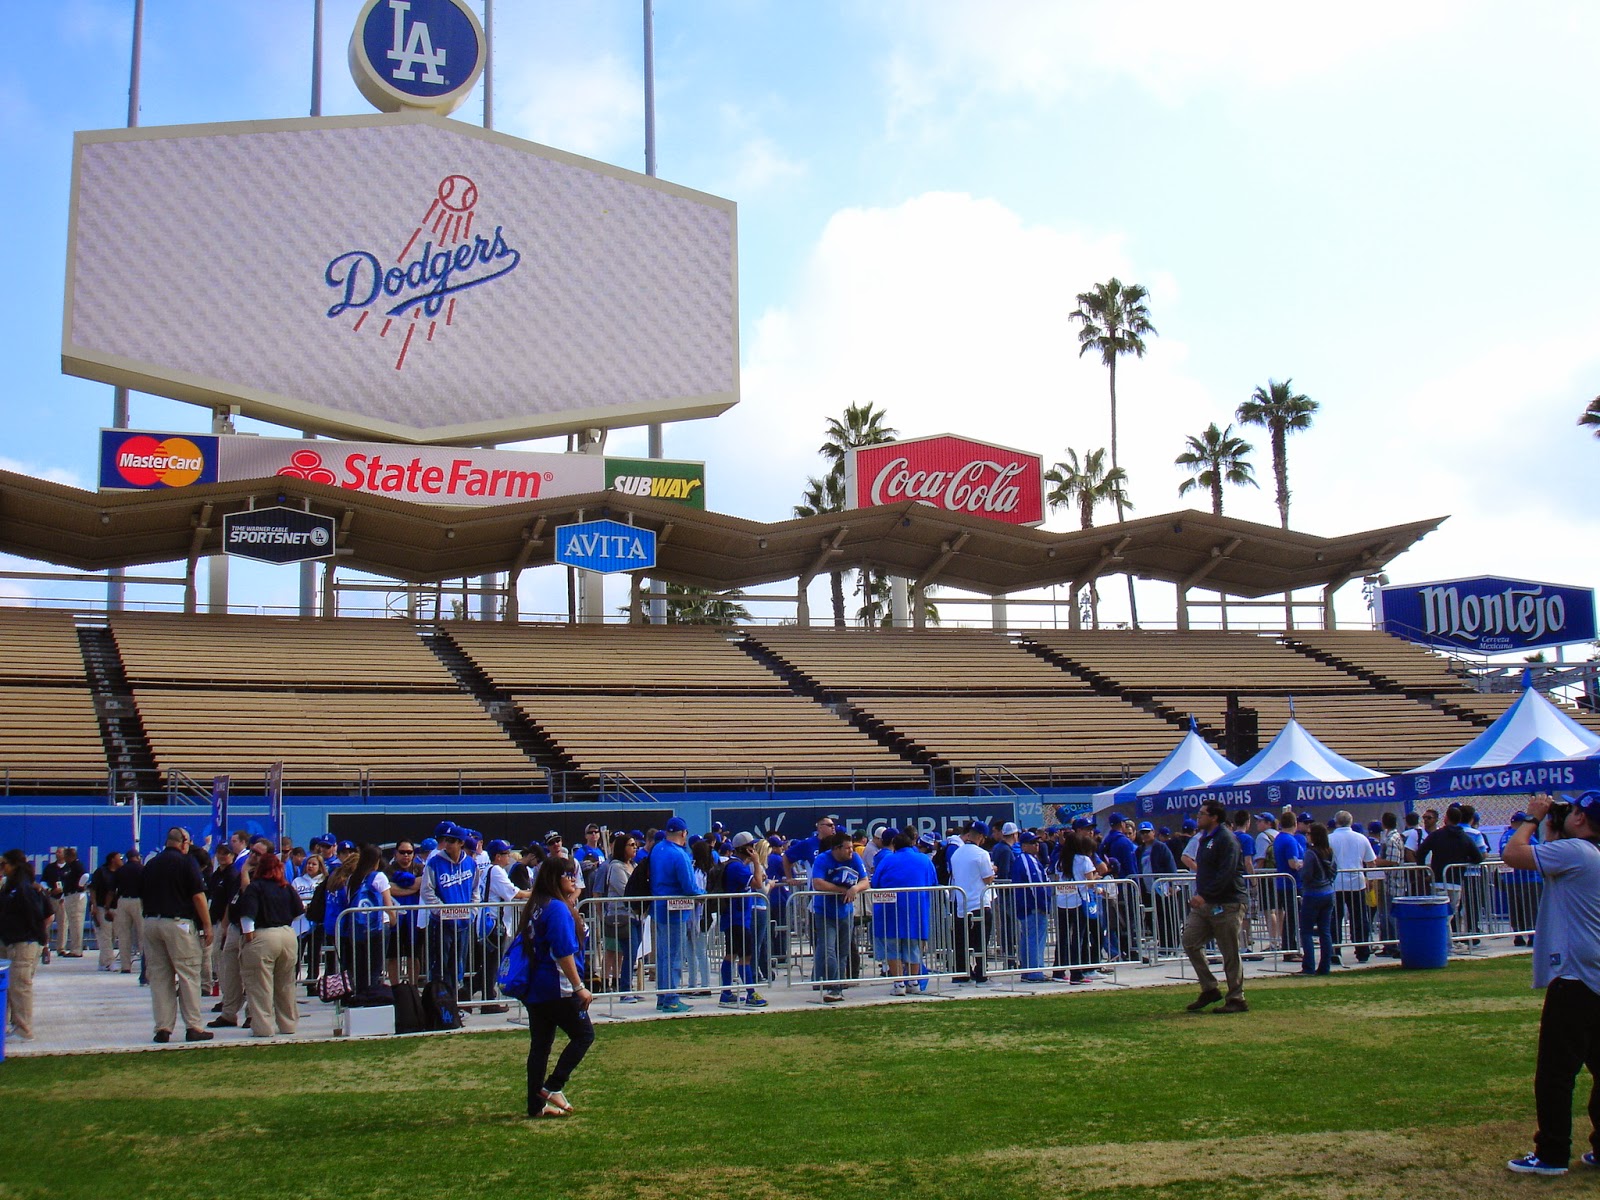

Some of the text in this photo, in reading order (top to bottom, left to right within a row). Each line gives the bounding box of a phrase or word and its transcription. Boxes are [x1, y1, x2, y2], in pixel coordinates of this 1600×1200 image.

[387, 1, 446, 85] LA
[325, 226, 520, 318] Dodgers
[119, 452, 202, 471] MasterCard
[609, 475, 701, 499] SUBWAY
[871, 457, 1028, 513] Coca-Cola
[229, 531, 310, 545] SPORTSNET
[564, 532, 648, 560] AVITA
[1419, 586, 1565, 641] Montejo
[1479, 642, 1514, 650] Mexicana
[1481, 635, 1510, 643] Cerveza
[1296, 780, 1396, 801] AUTOGRAPHS
[1449, 766, 1575, 792] AUTOGRAPHS
[216, 797, 223, 827] 3
[1018, 802, 1042, 816] 375
